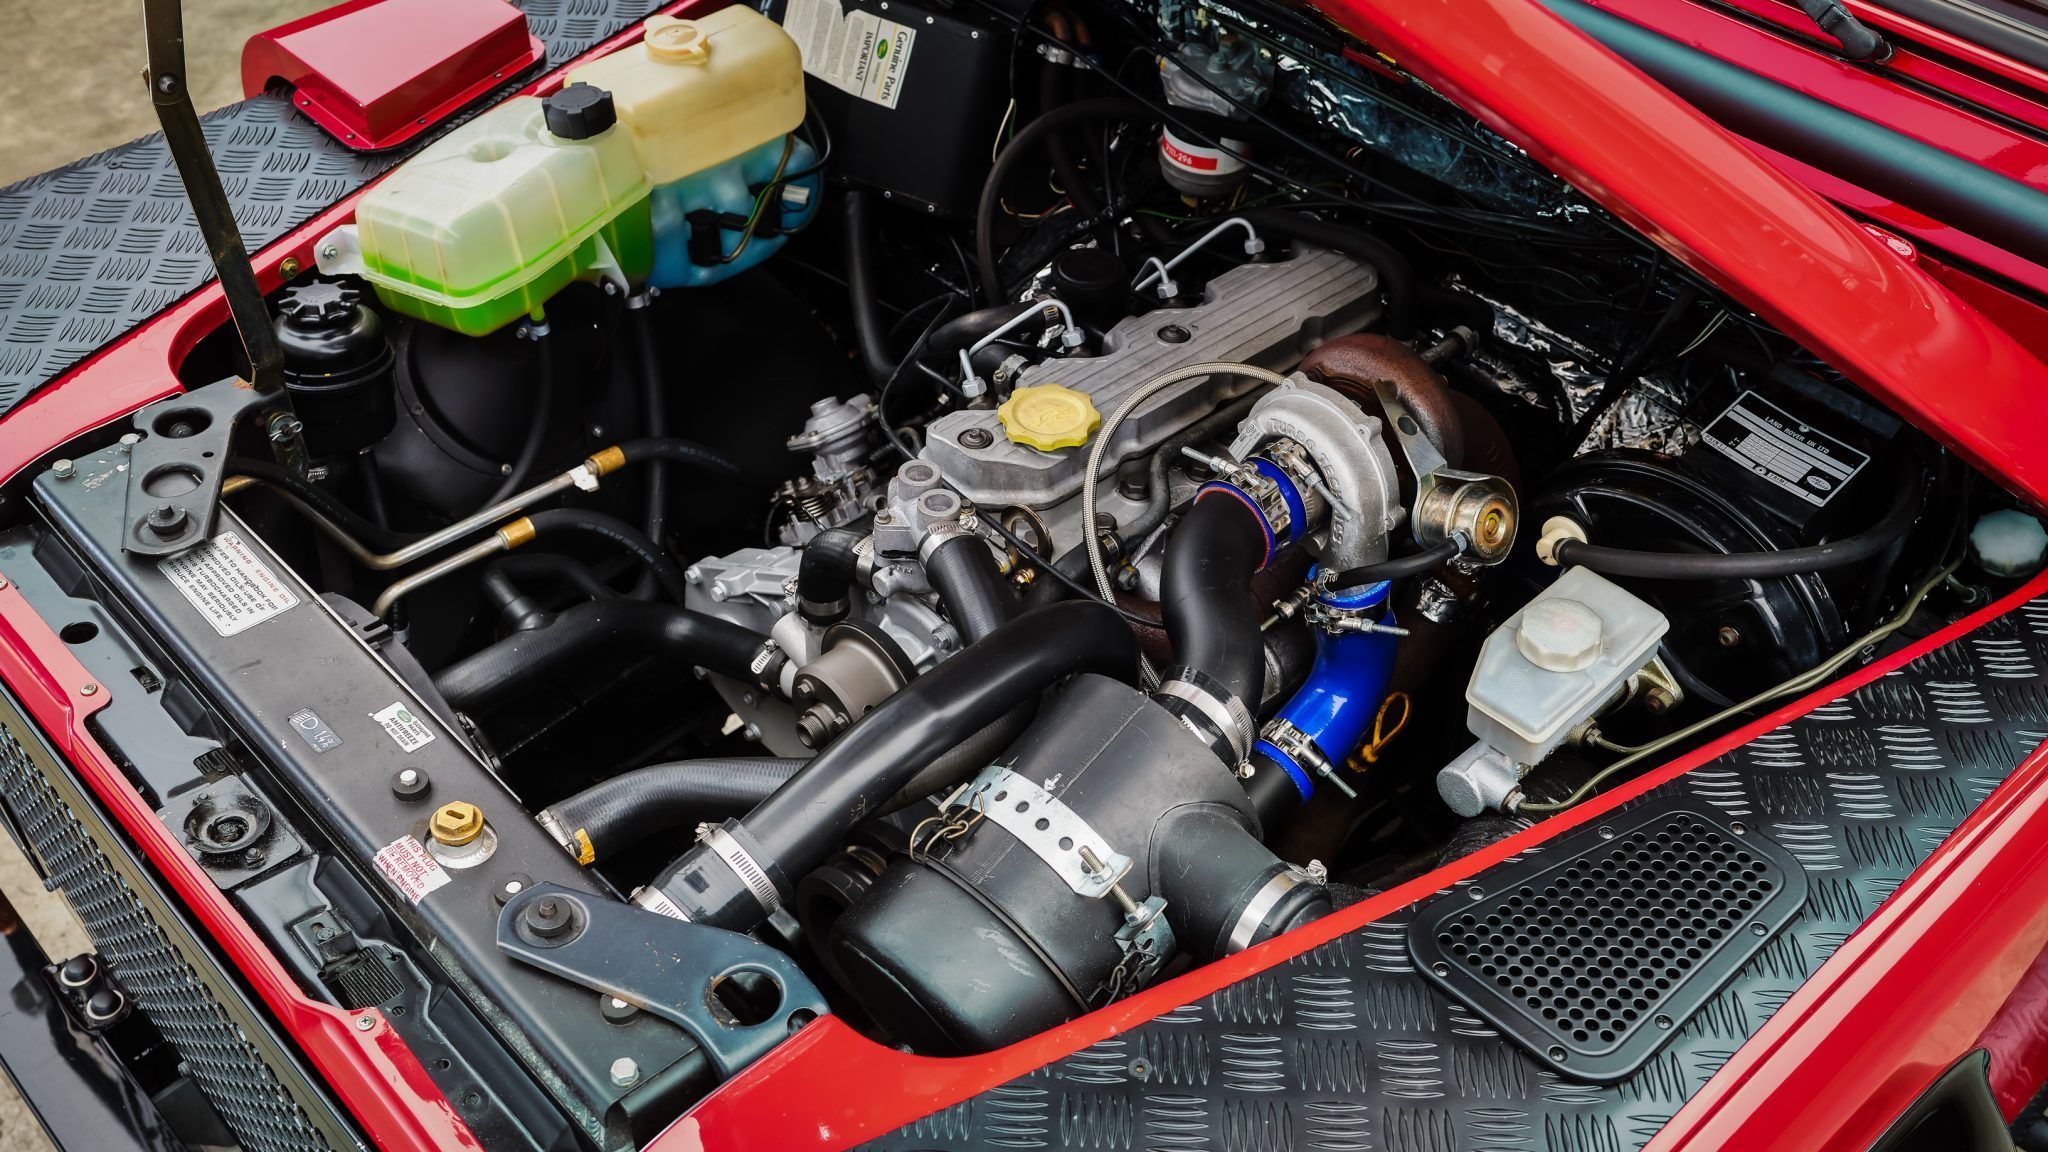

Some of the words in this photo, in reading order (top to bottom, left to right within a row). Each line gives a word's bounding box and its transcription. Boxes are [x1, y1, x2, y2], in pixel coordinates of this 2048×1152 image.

[855, 32, 873, 82] IMPORTANT
[888, 31, 908, 74] Genuine
[881, 76, 896, 102] Parts
[1765, 417, 1783, 429] LAND
[1784, 428, 1805, 441] ROVER
[1818, 445, 1830, 454] LTD
[1269, 418, 1316, 451] TURBO
[1318, 453, 1344, 544] TECHICS
[1770, 474, 1785, 483] TRIM
[211, 543, 230, 560] REFER
[223, 537, 252, 565] WARNING
[255, 570, 279, 592] ENGINE
[279, 594, 290, 603] OIL
[167, 562, 190, 583] REDUCE
[188, 585, 211, 606] ENGINE
[175, 559, 197, 578] ENGINE
[195, 579, 210, 591] MAY
[207, 592, 239, 622] SERIOUSLY
[184, 555, 198, 567] THIS
[196, 569, 243, 613] TURBOCHARGED
[192, 551, 206, 563] NON
[204, 563, 235, 593] APPROVED
[233, 594, 248, 606] OILS
[201, 547, 232, 576] APPROVED
[244, 592, 256, 602] USE
[255, 604, 266, 612] OF
[389, 717, 419, 745] ANTIFREEZE
[385, 848, 397, 857] BE
[394, 857, 425, 889] REMOVED
[395, 842, 416, 862] MUST
[411, 861, 427, 876] NOT
[405, 837, 422, 852] THIS
[419, 853, 438, 871] PLUG
[378, 855, 398, 875] WHEN
[395, 876, 421, 901] ENGINE
